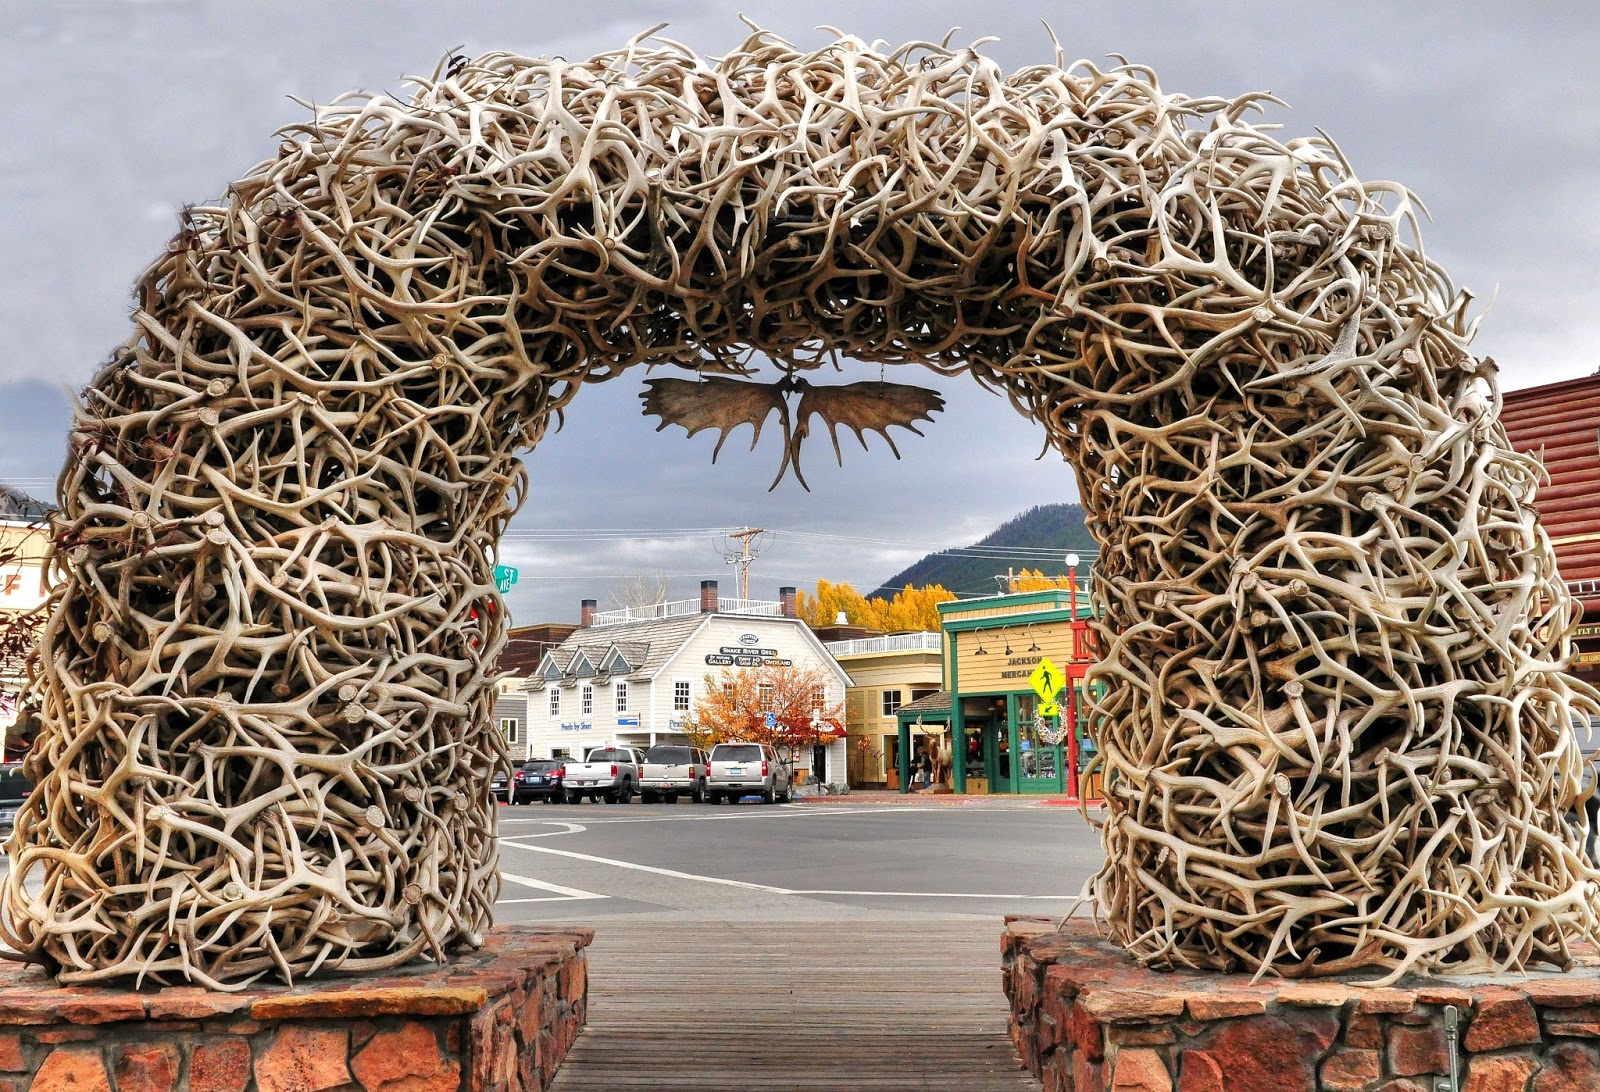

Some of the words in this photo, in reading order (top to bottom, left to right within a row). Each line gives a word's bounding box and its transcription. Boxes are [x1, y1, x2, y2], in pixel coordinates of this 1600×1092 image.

[503, 568, 515, 584] ST
[500, 577, 510, 592] AVE
[1008, 656, 1042, 666] JACKSON
[1002, 669, 1034, 678] MERCAN
[574, 721, 580, 732] by
